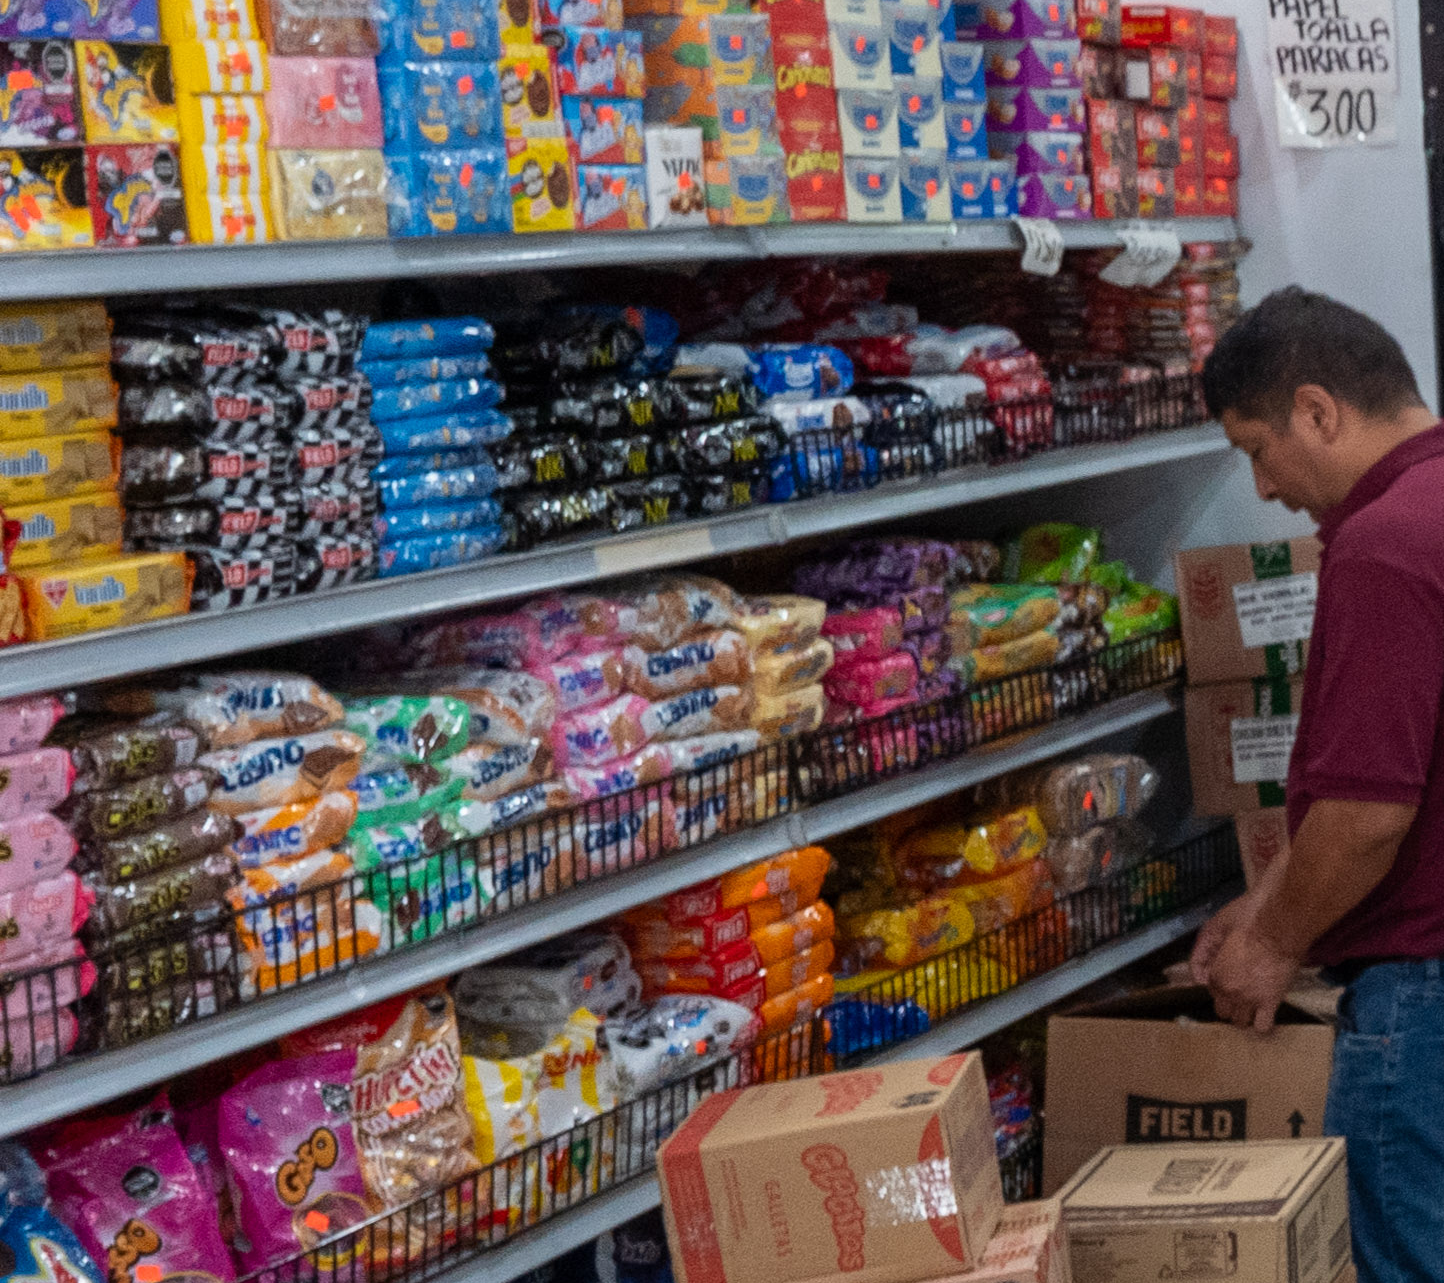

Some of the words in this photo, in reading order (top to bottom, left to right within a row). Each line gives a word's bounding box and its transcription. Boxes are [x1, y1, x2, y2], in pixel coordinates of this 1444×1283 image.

[1293, 16, 1391, 44] TOALLA
[1275, 44, 1389, 76] PARACAS
[1138, 1106, 1234, 1139] FIELD
